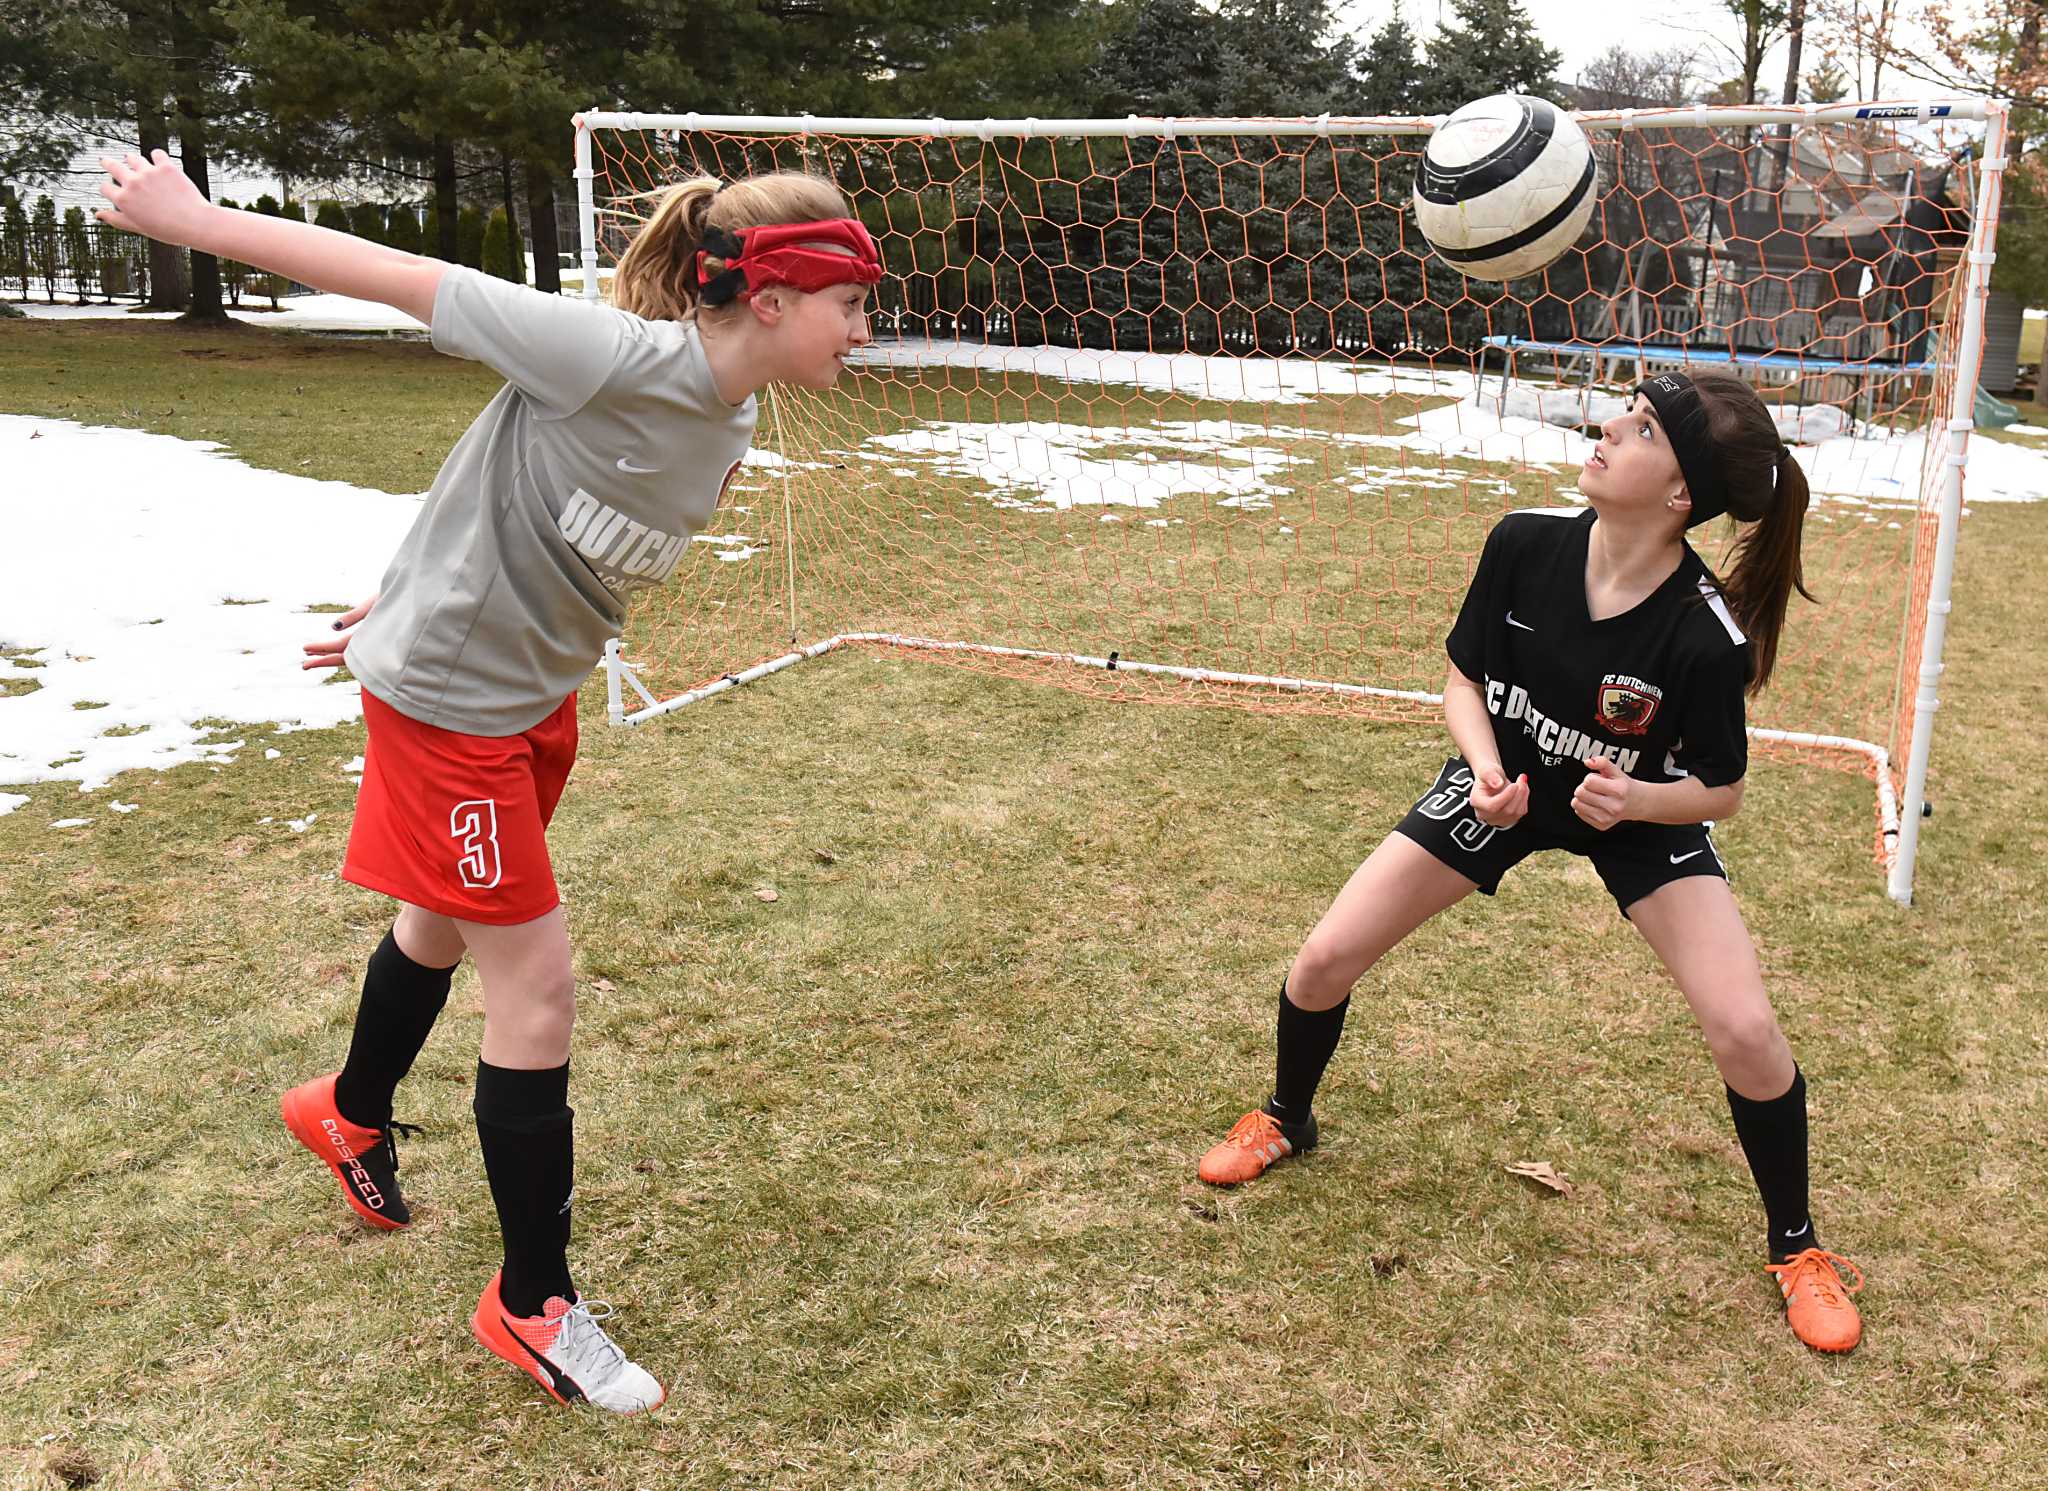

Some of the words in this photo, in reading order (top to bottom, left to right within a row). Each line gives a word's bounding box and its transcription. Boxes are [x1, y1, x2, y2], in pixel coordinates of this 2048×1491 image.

[557, 488, 690, 582] DUTCH
[1484, 672, 1505, 715] C
[1602, 674, 1616, 684] FC
[1616, 674, 1663, 700] DUTCHMEN
[450, 799, 502, 889] 3
[320, 1119, 385, 1209] EVOSPEED
